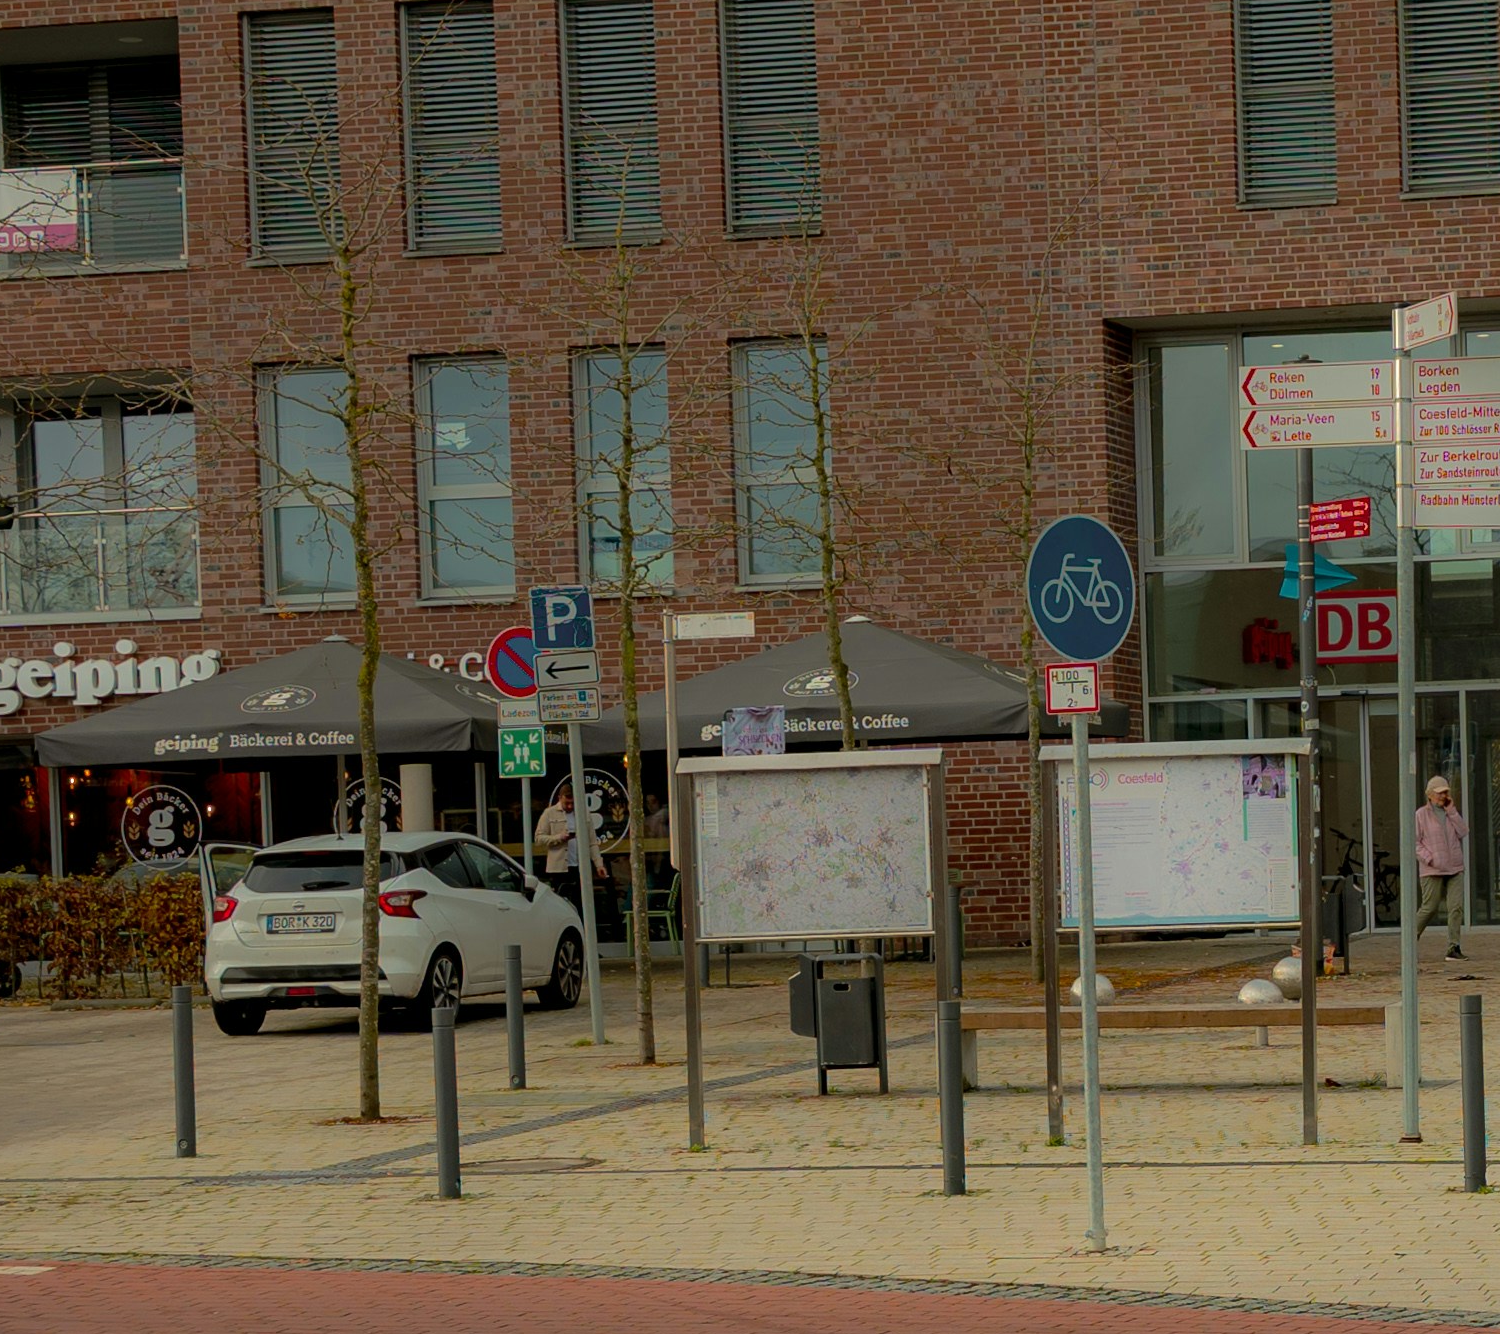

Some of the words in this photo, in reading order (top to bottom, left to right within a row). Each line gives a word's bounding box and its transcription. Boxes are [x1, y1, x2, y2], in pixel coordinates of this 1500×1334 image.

[1269, 372, 1304, 383] Reken
[1370, 368, 1380, 379] 19
[1419, 365, 1459, 377] Borken
[1269, 388, 1313, 400] Dülmen
[1371, 384, 1380, 395] 10
[1419, 382, 1461, 396] Legden
[1269, 414, 1335, 426] Maria-Veen
[1371, 411, 1381, 421] 15
[1419, 406, 1500, 420] Coesfeld-Mitte
[1284, 430, 1312, 442] Lette
[1419, 426, 1433, 436] Zur
[1435, 425, 1450, 435] 100
[1451, 423, 1492, 435] Schlösser
[1420, 452, 1439, 463] Zur
[1420, 468, 1434, 479] Zur
[1420, 493, 1459, 506] Radbahn
[545, 595, 577, 641] P
[1317, 602, 1392, 652] DB
[1051, 671, 1059, 681] H
[1061, 670, 1079, 681] 100
[502, 709, 537, 718] Ladezon
[862, 714, 909, 729] Coffee
[154, 733, 219, 756] geiping
[229, 732, 293, 748] Bäckerei
[295, 732, 306, 746] &
[308, 730, 355, 745] Coffee
[1117, 772, 1164, 785] Coesfeld
[585, 775, 619, 797] Bäcker
[131, 796, 154, 816] Dein
[156, 792, 190, 814] Bäcker
[147, 805, 175, 847] g
[273, 917, 295, 929] BOR
[303, 916, 310, 928] K
[312, 915, 333, 928] 320
